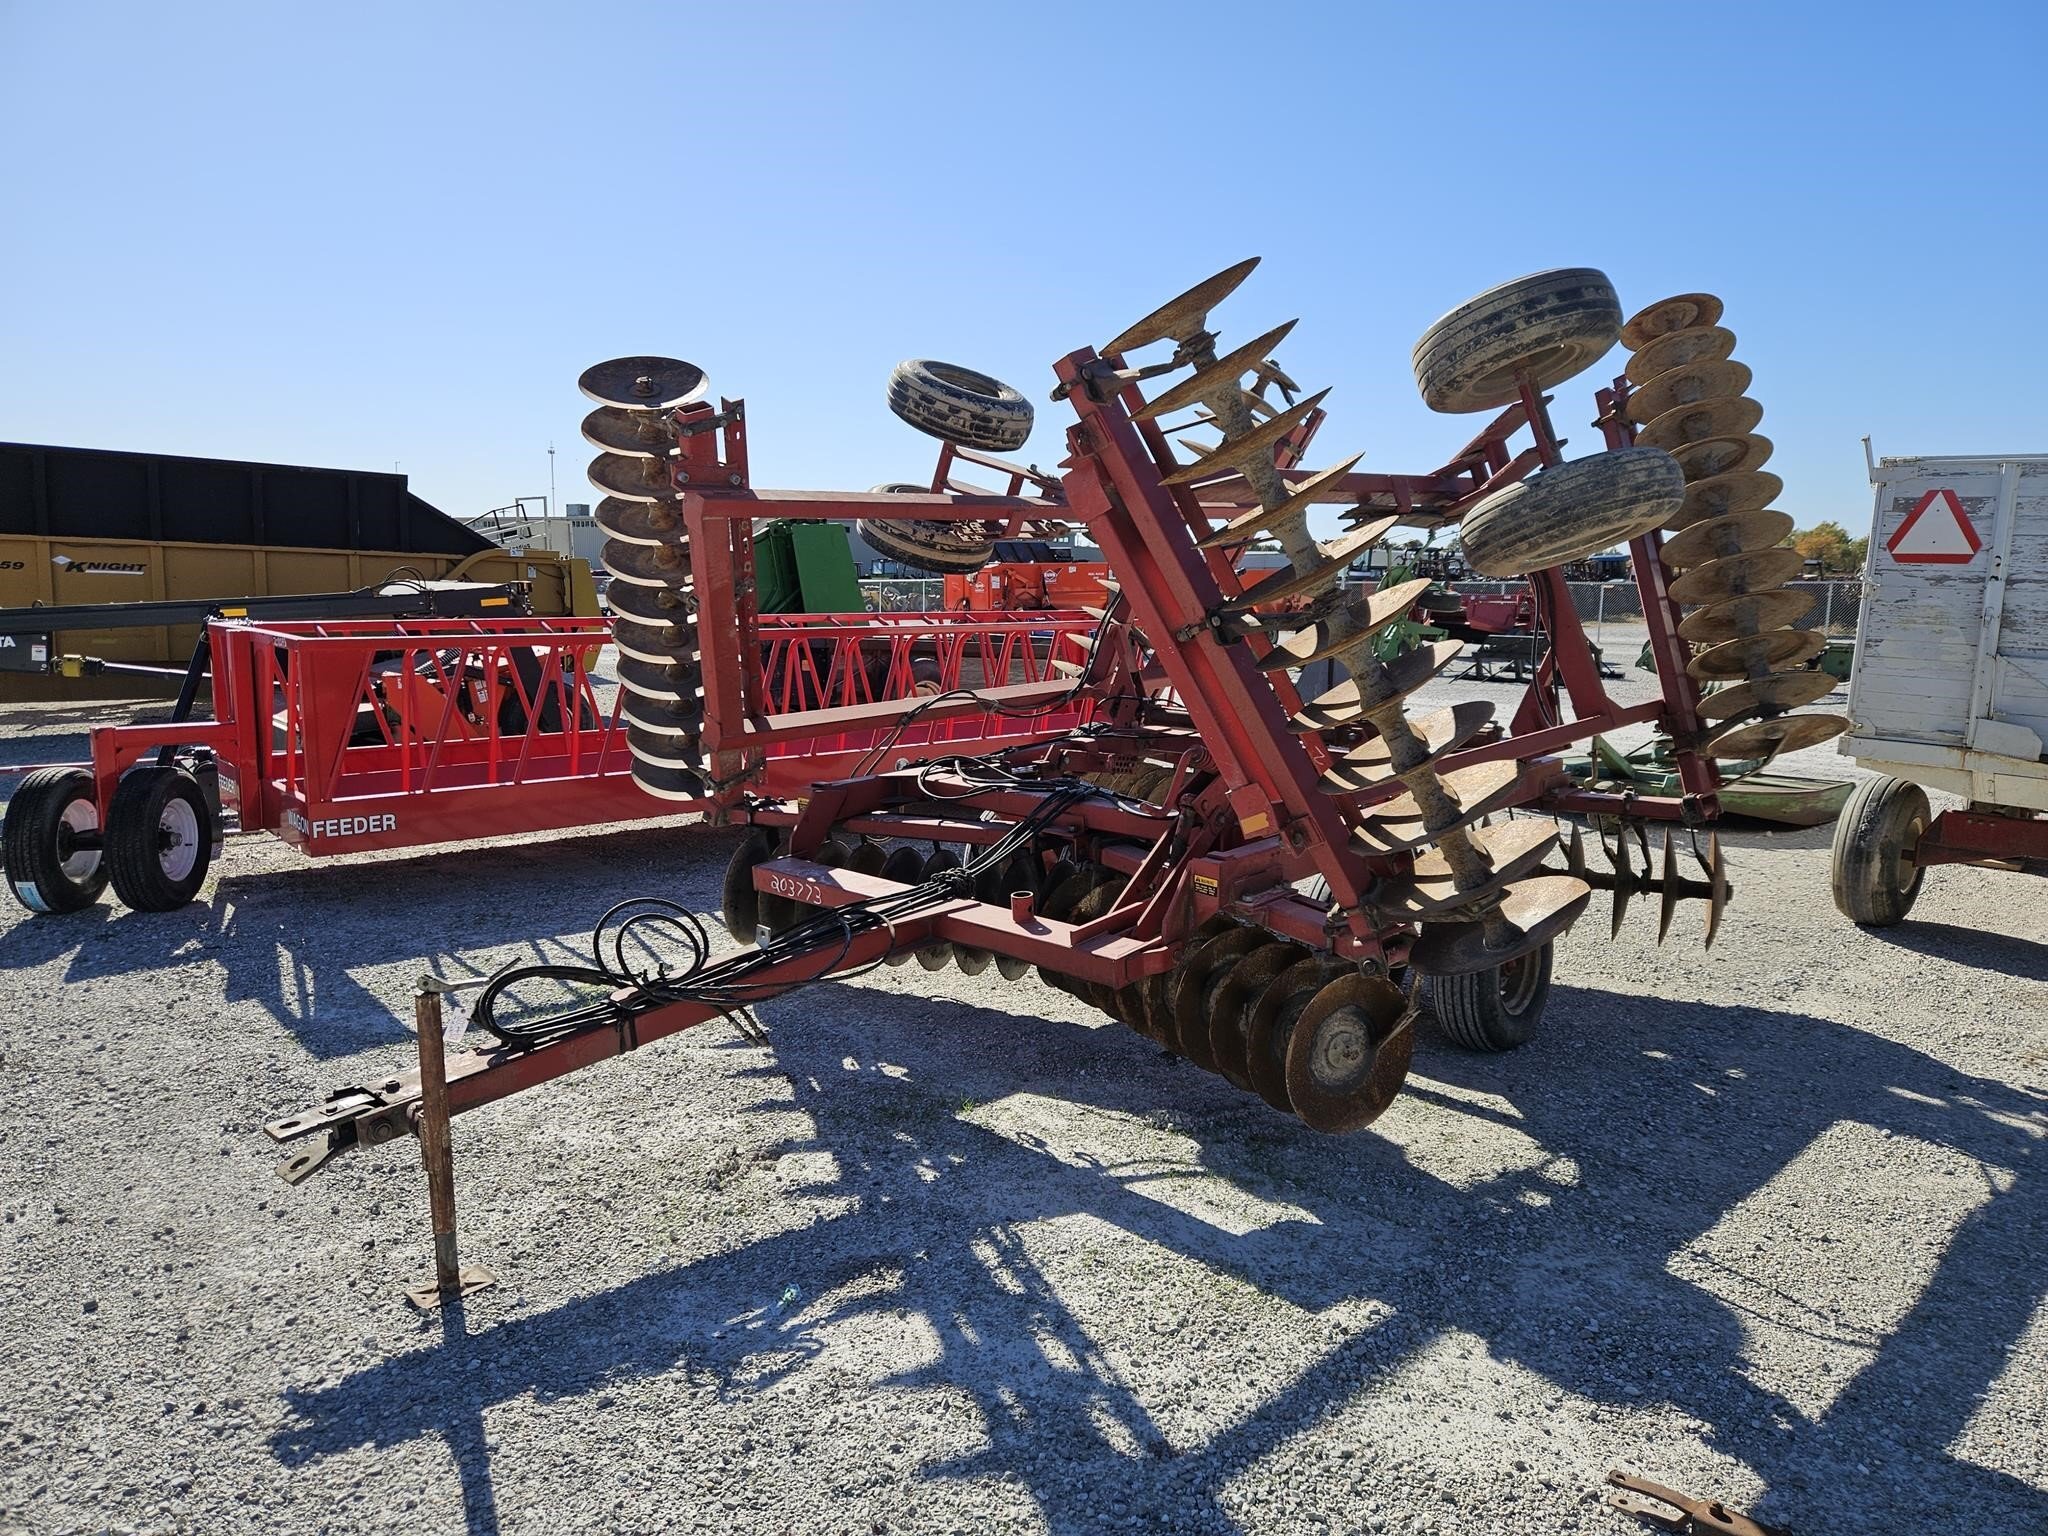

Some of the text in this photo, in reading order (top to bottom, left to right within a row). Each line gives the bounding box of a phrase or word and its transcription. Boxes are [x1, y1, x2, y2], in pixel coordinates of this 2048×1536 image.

[64, 561, 148, 573] KNIGHT
[312, 813, 397, 839] FEEDER
[770, 874, 822, 905] 203773
